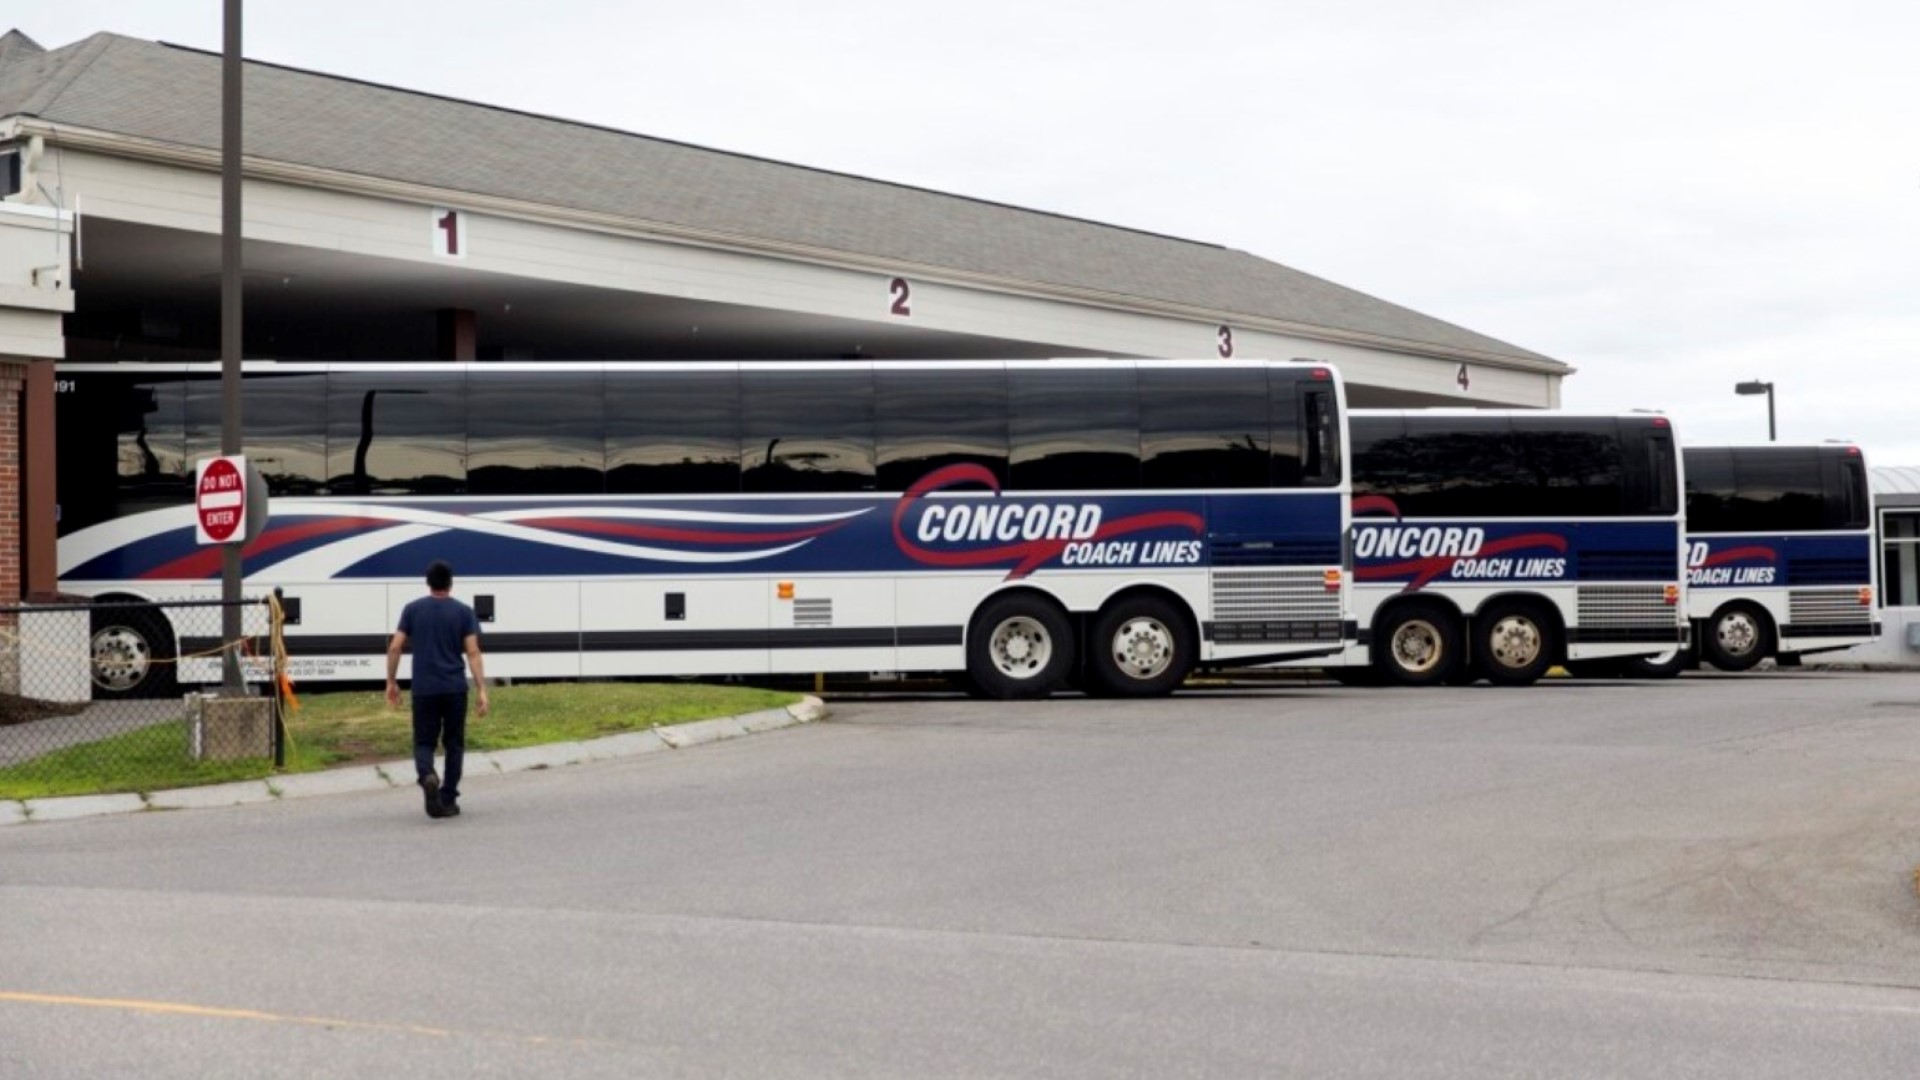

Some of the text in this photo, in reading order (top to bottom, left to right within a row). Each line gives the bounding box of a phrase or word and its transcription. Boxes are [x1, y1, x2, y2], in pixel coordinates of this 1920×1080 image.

[438, 210, 458, 255] 1
[890, 277, 911, 317] 2
[1217, 325, 1233, 359] 3
[1456, 363, 1470, 391] 4
[203, 474, 237, 490] DO NOT
[206, 511, 234, 526] ENTER
[917, 504, 1102, 541] CONCORD
[1061, 541, 1202, 564] COACH LINES
[1351, 527, 1484, 558] ONCORD
[1451, 558, 1566, 578] COACH LINES
[1733, 567, 1776, 583] LINES
